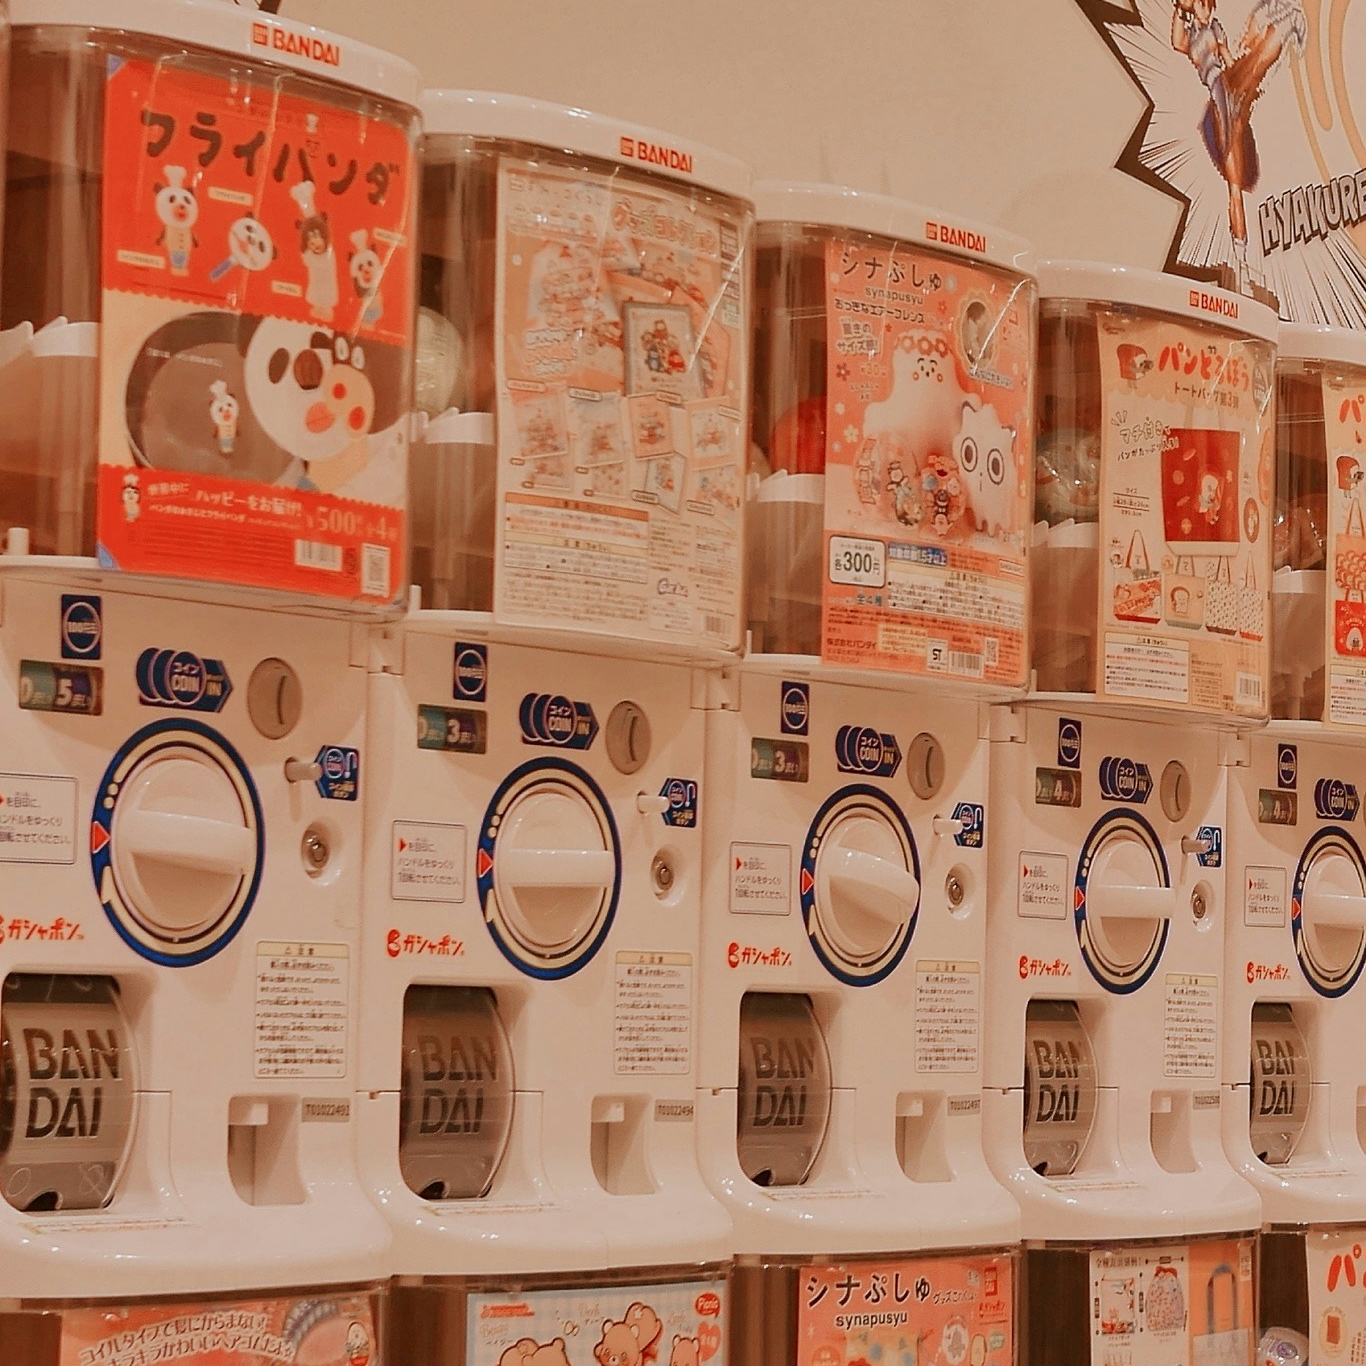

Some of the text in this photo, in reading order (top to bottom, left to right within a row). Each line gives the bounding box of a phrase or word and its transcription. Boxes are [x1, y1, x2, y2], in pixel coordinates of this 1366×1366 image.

[272, 27, 341, 67] BANDAI
[637, 141, 693, 174] BANDAI
[939, 225, 987, 254] BANDAI
[839, 251, 942, 292] シナぷしゅ
[864, 285, 924, 306] synapusyu
[1200, 292, 1239, 320] BANDAI
[171, 675, 200, 693] COIN
[172, 661, 200, 675] コイン
[548, 716, 573, 734] COIN
[549, 704, 572, 717] コイン
[858, 746, 880, 763] COIN
[859, 736, 880, 748] コイン
[1117, 775, 1136, 791] COIN
[22, 1028, 122, 1081] BAN
[417, 1034, 497, 1081] BAN
[752, 1037, 816, 1080] BAN
[1033, 1039, 1082, 1079] BAN
[24, 1086, 103, 1139] DAI
[419, 1087, 484, 1135] DAI
[752, 1085, 808, 1128] DAI
[1035, 1084, 1080, 1123] DAI
[1259, 1080, 1296, 1117] DAI
[805, 1272, 931, 1308] シナぷしゅ
[835, 1310, 908, 1331] synapusyu
